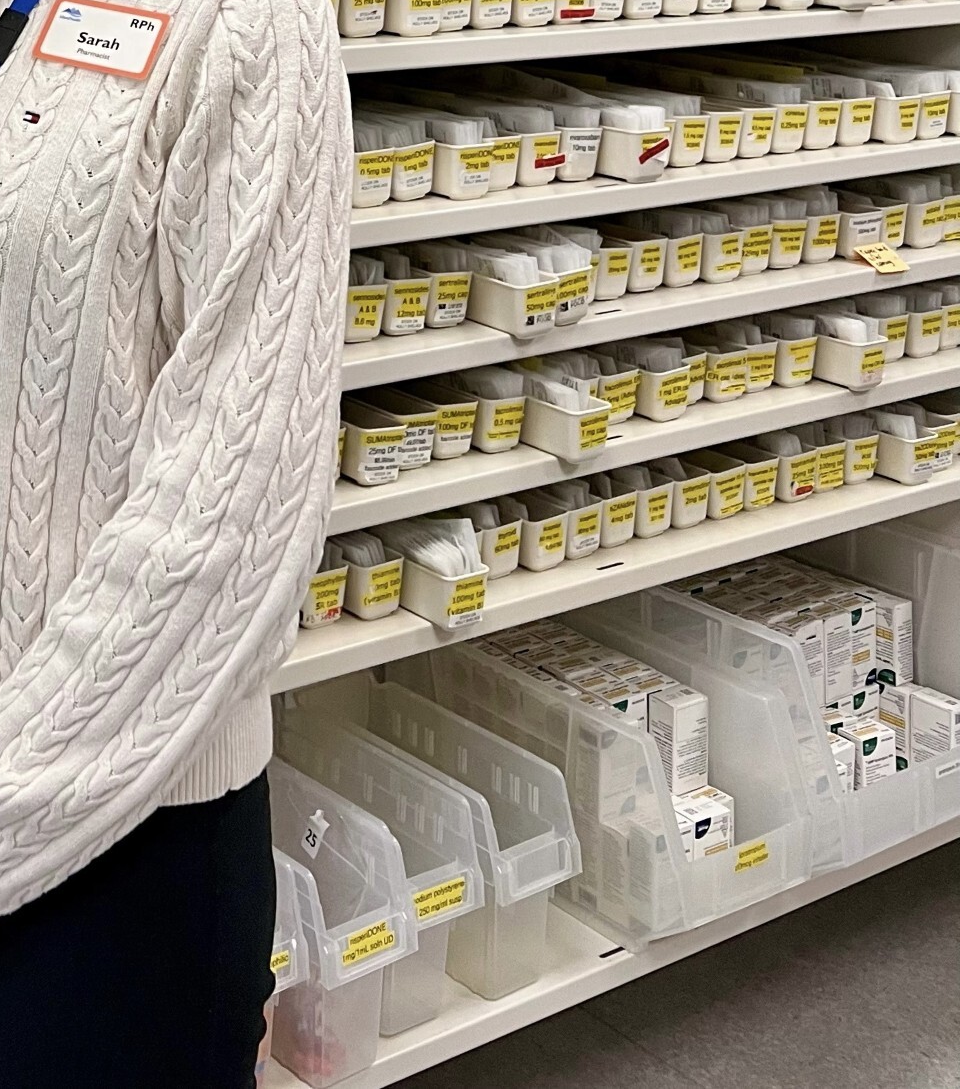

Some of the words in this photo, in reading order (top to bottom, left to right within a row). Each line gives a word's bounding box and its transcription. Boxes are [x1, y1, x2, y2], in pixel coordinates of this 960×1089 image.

[130, 18, 155, 32] RPh
[77, 31, 120, 51] Sarah
[76, 47, 110, 60] Pharmacist
[304, 828, 318, 848] 25
